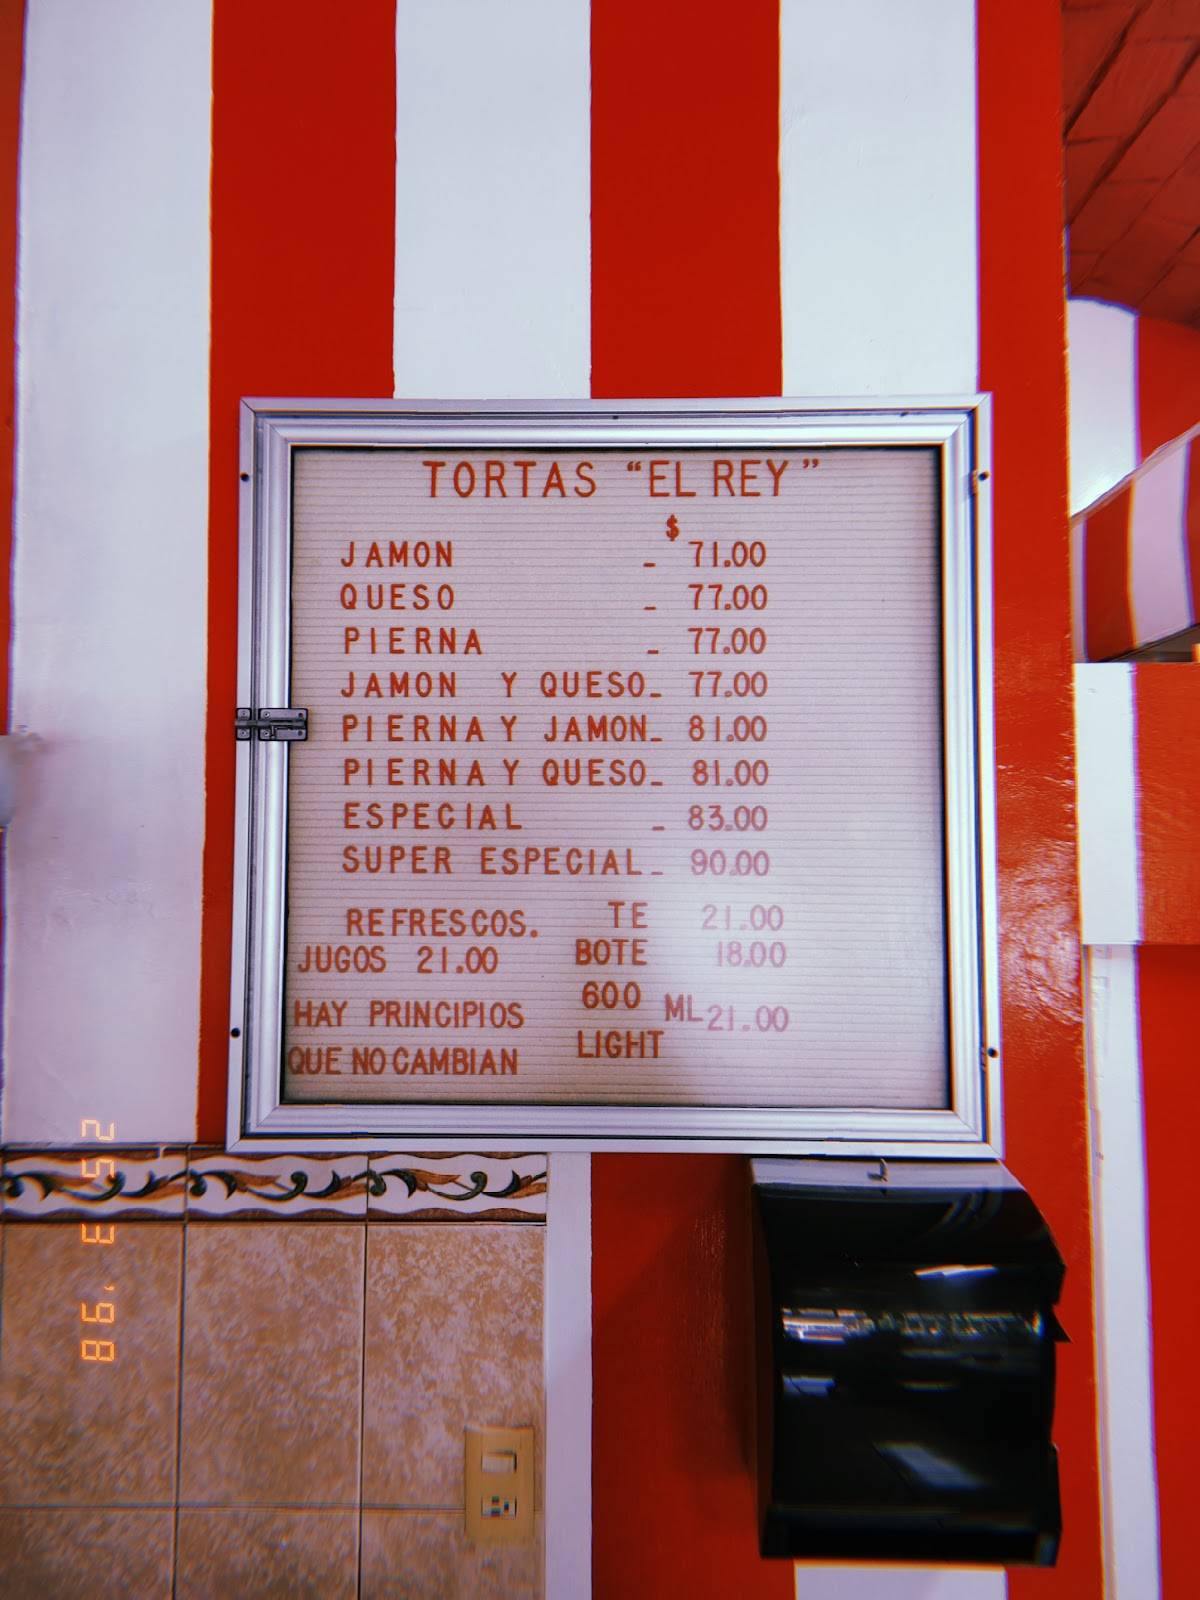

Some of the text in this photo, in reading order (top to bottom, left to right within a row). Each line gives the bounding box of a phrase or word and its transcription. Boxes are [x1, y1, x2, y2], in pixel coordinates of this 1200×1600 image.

[422, 460, 596, 498] TORTAS
[665, 513, 680, 542] $
[340, 540, 454, 568] JAMON
[688, 540, 767, 568] 71.00
[339, 583, 455, 611] QUESO
[688, 583, 769, 611] 77.00
[343, 626, 483, 655] PIERNA
[687, 626, 768, 655] 77.00
[340, 671, 457, 698] JAMON
[501, 671, 518, 698] Y
[688, 671, 769, 698] 77.00
[342, 714, 485, 743] PIERNA
[500, 714, 518, 743] Y
[688, 714, 768, 743] 81.00
[343, 758, 486, 787] PIERNA
[502, 758, 520, 787] Y
[692, 758, 769, 787] 81.00
[343, 802, 523, 831] ESPECIAL
[688, 804, 769, 831] 83.00
[342, 845, 452, 874] SUPER
[480, 846, 643, 876] ESPECIAL
[690, 848, 770, 877] 90.00
[346, 908, 539, 938] REFRESCOS.
[608, 902, 784, 932] TE 21.00
[298, 945, 498, 974] JUGOS 21.00
[575, 938, 788, 969] BOTE 18.00
[294, 1000, 525, 1030] HAY PRINCIPIOS
[582, 980, 790, 1033] 600 ML 21.00
[577, 1030, 664, 1059] LIGHT
[288, 1046, 519, 1076] QUE NO CAMBIAN
